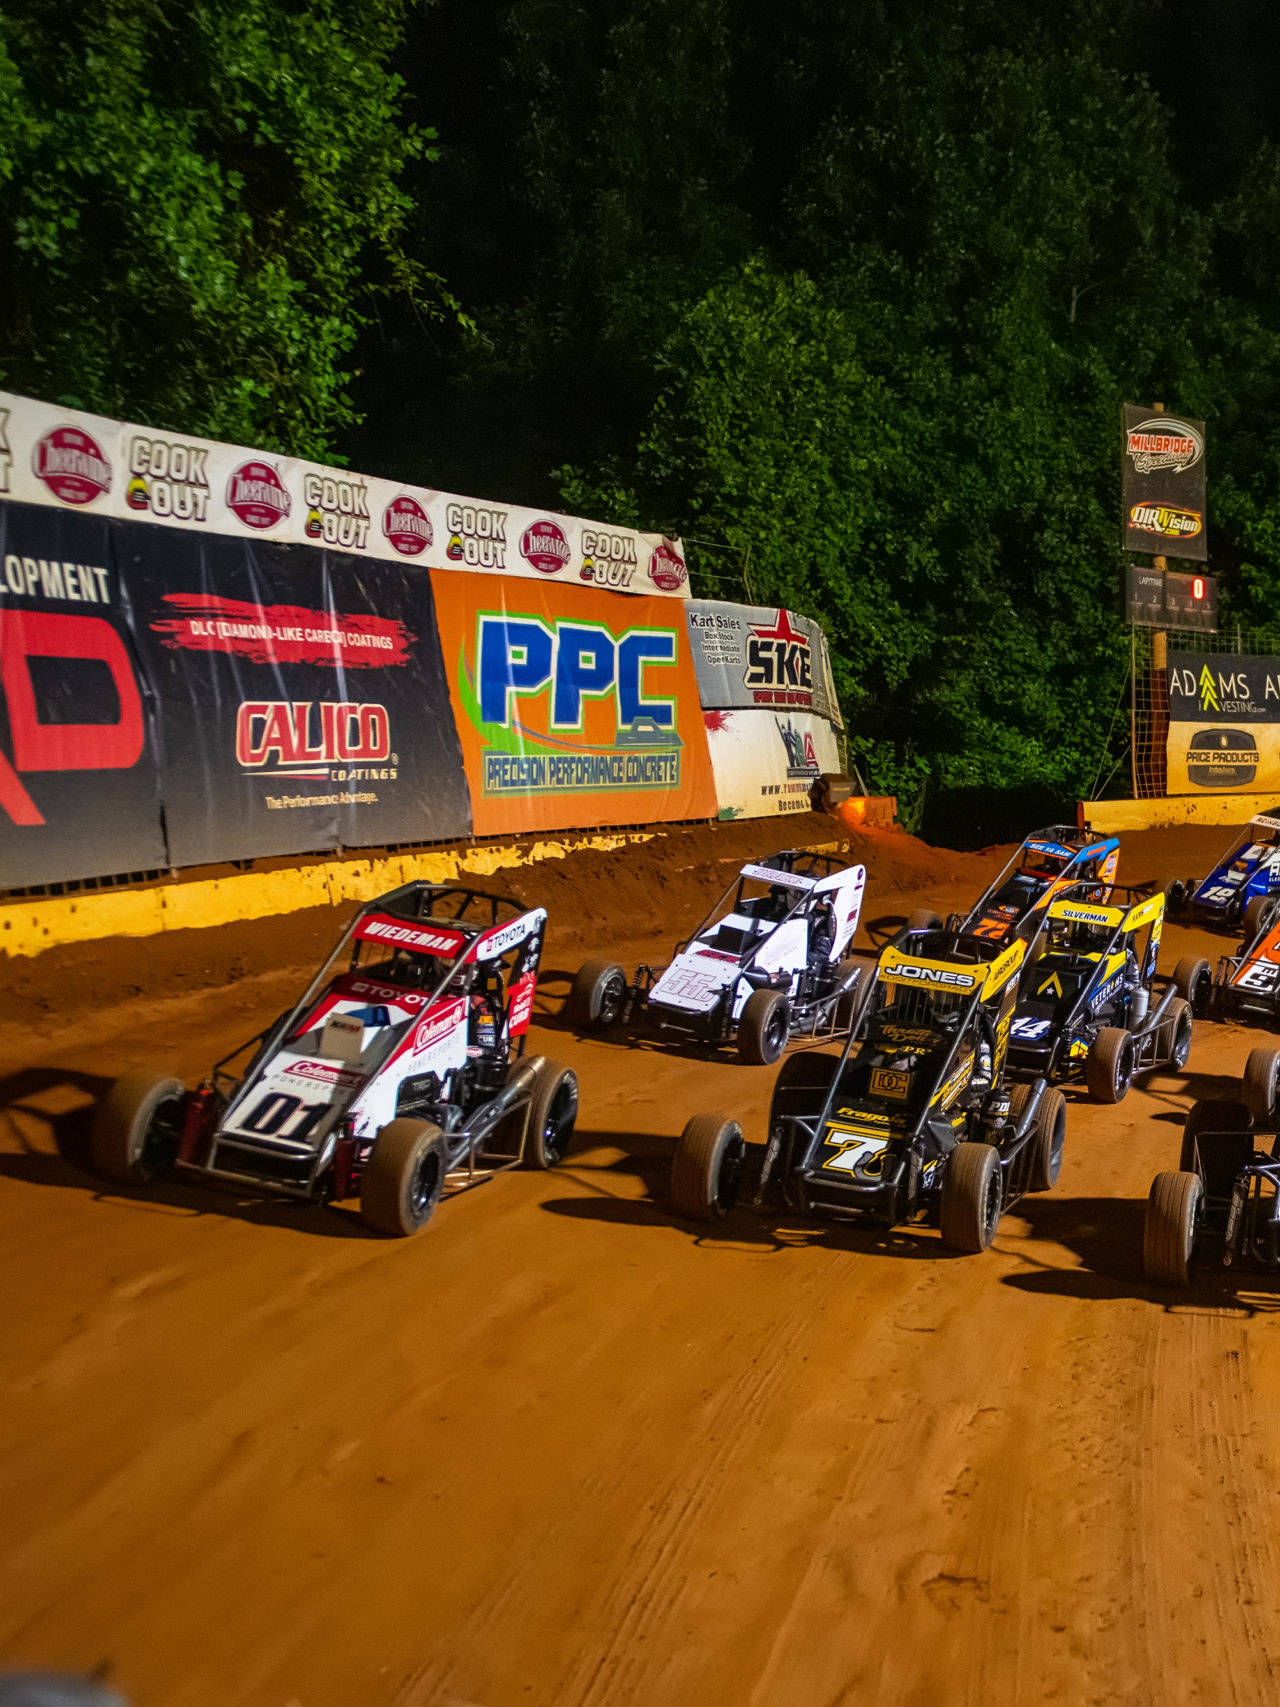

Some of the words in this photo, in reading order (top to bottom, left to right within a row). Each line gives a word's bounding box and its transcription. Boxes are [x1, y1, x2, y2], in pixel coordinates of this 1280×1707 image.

[1129, 433, 1194, 454] MILLBRIDGE
[130, 436, 208, 488] COOK
[1134, 452, 1192, 472] Speedway
[151, 480, 209, 521] OUT
[305, 473, 368, 517] COOK
[323, 511, 370, 549] OUT
[447, 504, 508, 541] COOK
[463, 537, 506, 569] OUT
[581, 530, 636, 563] COOK
[594, 559, 636, 586] OUT
[689, 613, 714, 628] Kart
[716, 615, 741, 630] Sales
[348, 633, 393, 650] COATINGS
[476, 612, 678, 731] PPC
[236, 701, 391, 767] CALICO
[488, 756, 546, 789] PRECISION
[548, 755, 624, 787] PERFORMANCE
[1186, 751, 1211, 763] PRICE
[1212, 751, 1260, 763] PRODUCTS
[331, 768, 398, 781] COATINGS
[1062, 909, 1108, 923] SILVERMAN
[363, 921, 459, 951] WIEDEMAN
[493, 923, 526, 949] TOYOTA
[884, 963, 975, 988] JONES
[417, 1010, 457, 1046] Coleman
[1010, 1017, 1050, 1038] 14
[292, 1061, 357, 1088] Coleman
[237, 1091, 332, 1144] 01
